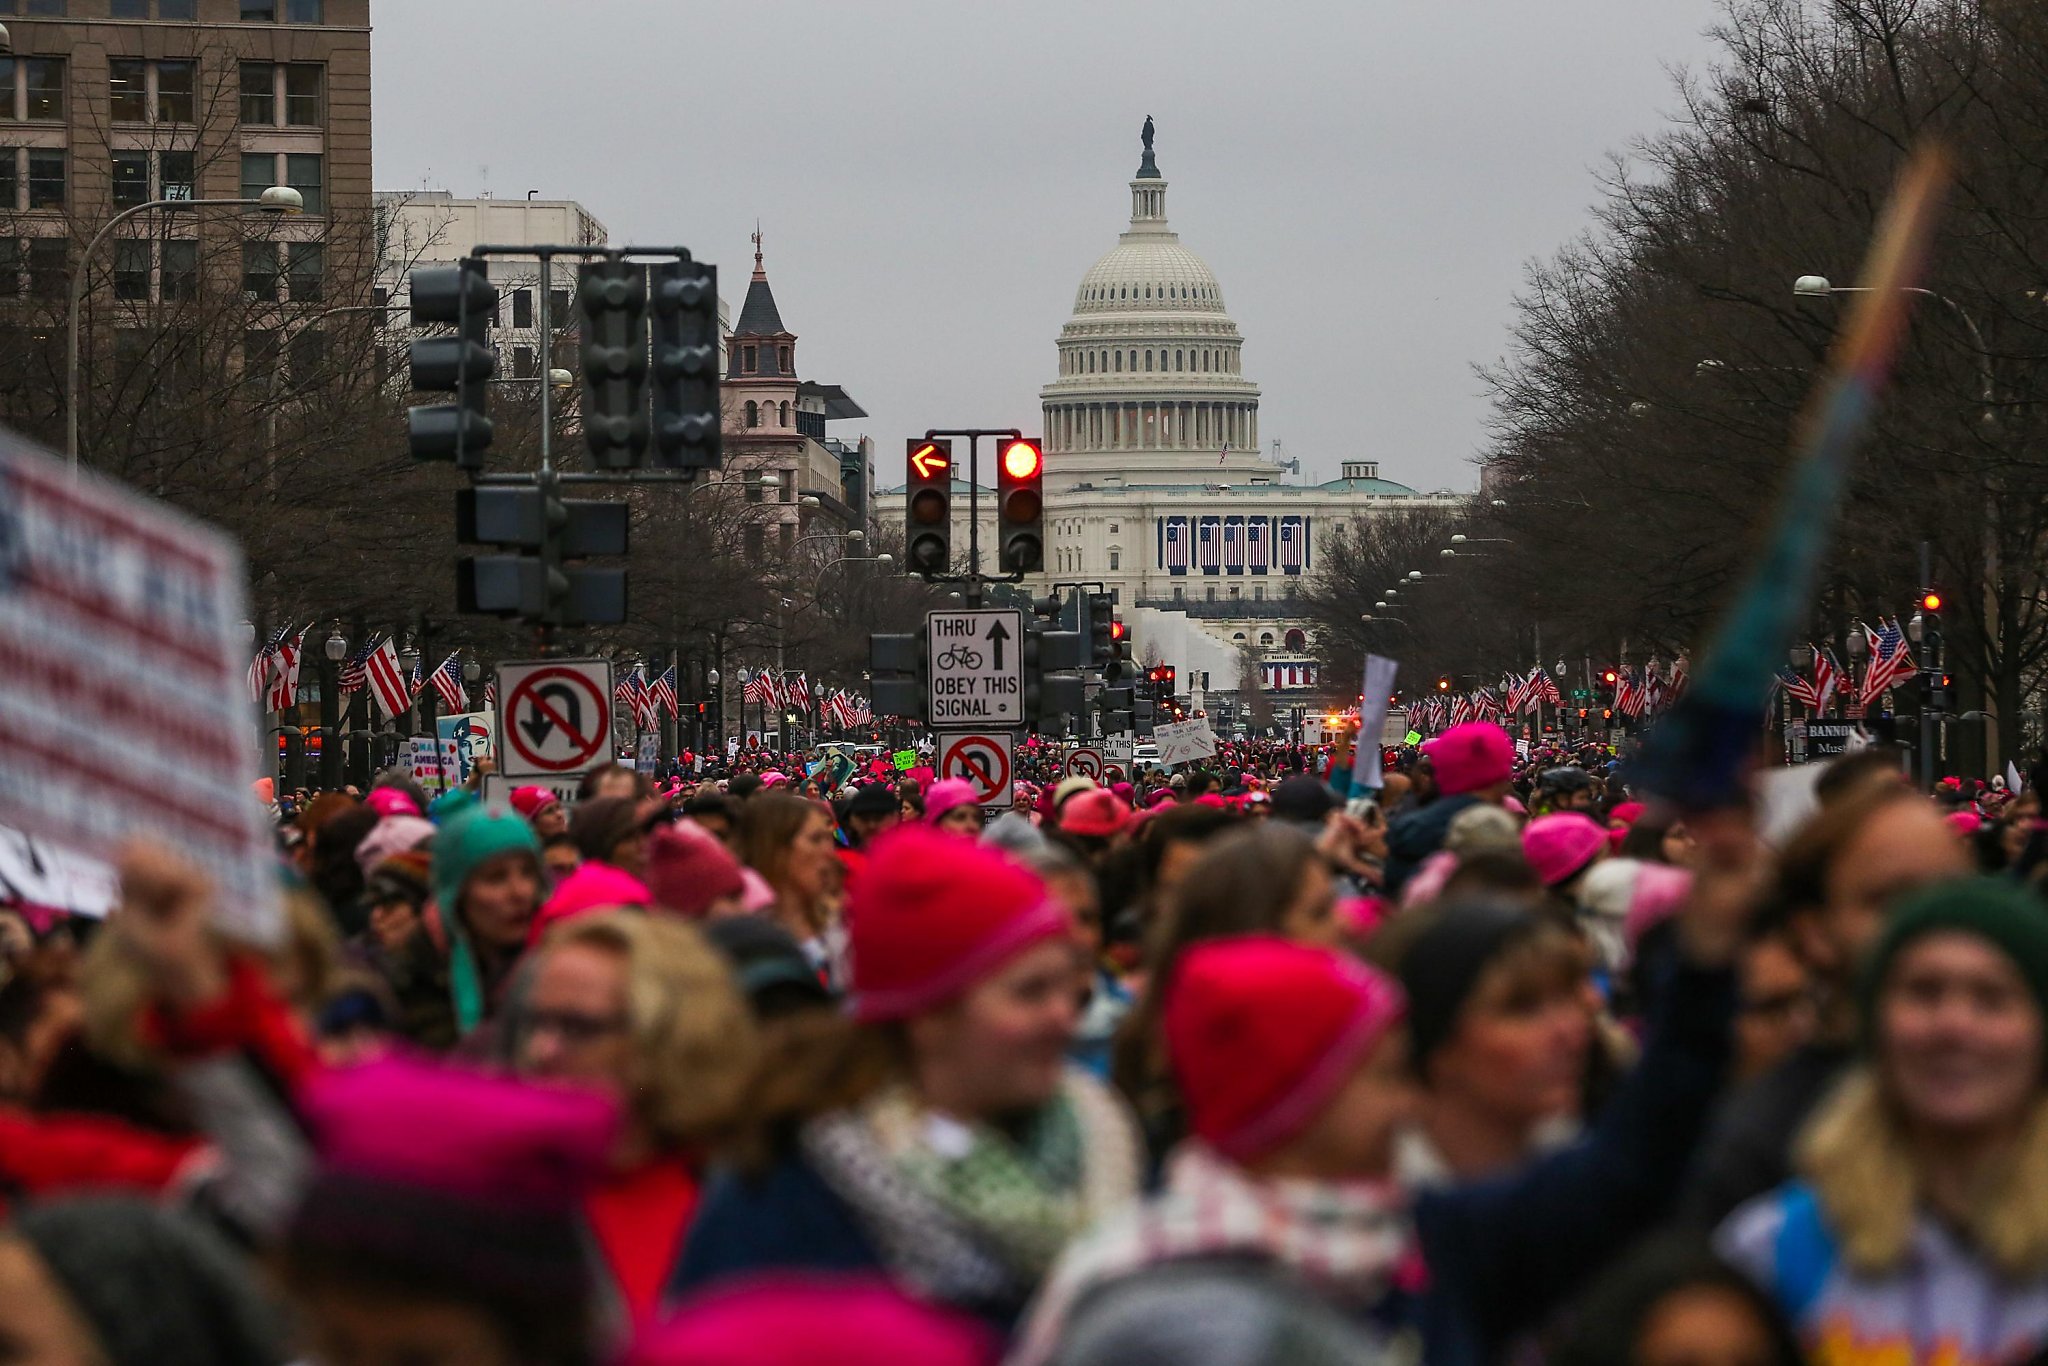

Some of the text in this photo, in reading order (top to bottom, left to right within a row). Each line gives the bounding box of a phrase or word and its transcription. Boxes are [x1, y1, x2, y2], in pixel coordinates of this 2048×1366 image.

[935, 618, 976, 636] THRU
[935, 676, 1017, 694] OBEY THIS
[935, 699, 991, 716] SIGNAL
[1094, 740, 1131, 748] OBEY THIS
